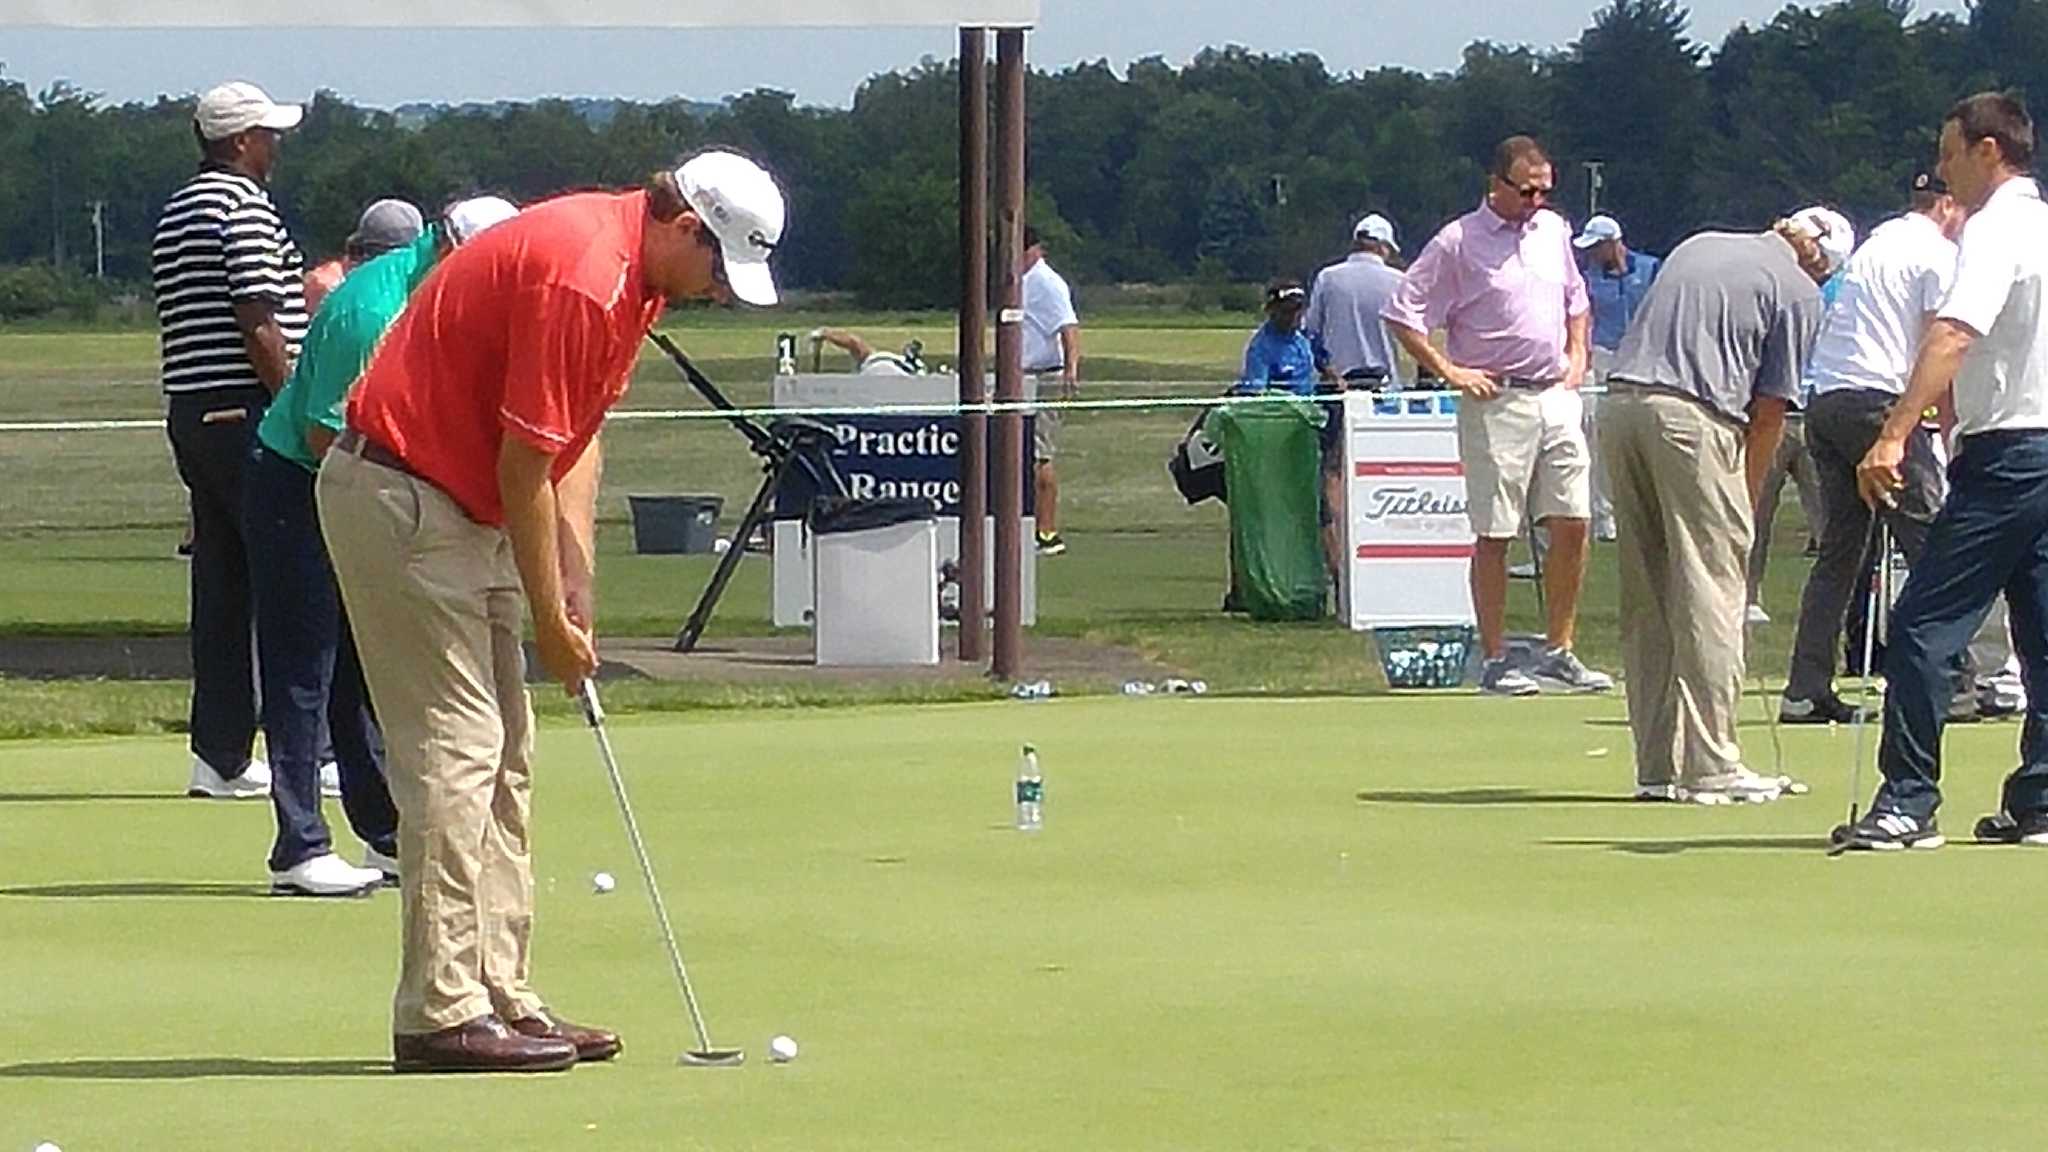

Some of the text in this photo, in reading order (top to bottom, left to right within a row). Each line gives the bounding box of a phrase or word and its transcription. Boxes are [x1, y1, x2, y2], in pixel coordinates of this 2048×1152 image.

[832, 423, 960, 455] Practic
[850, 473, 960, 511] Range
[1365, 487, 1468, 519] Titleis
